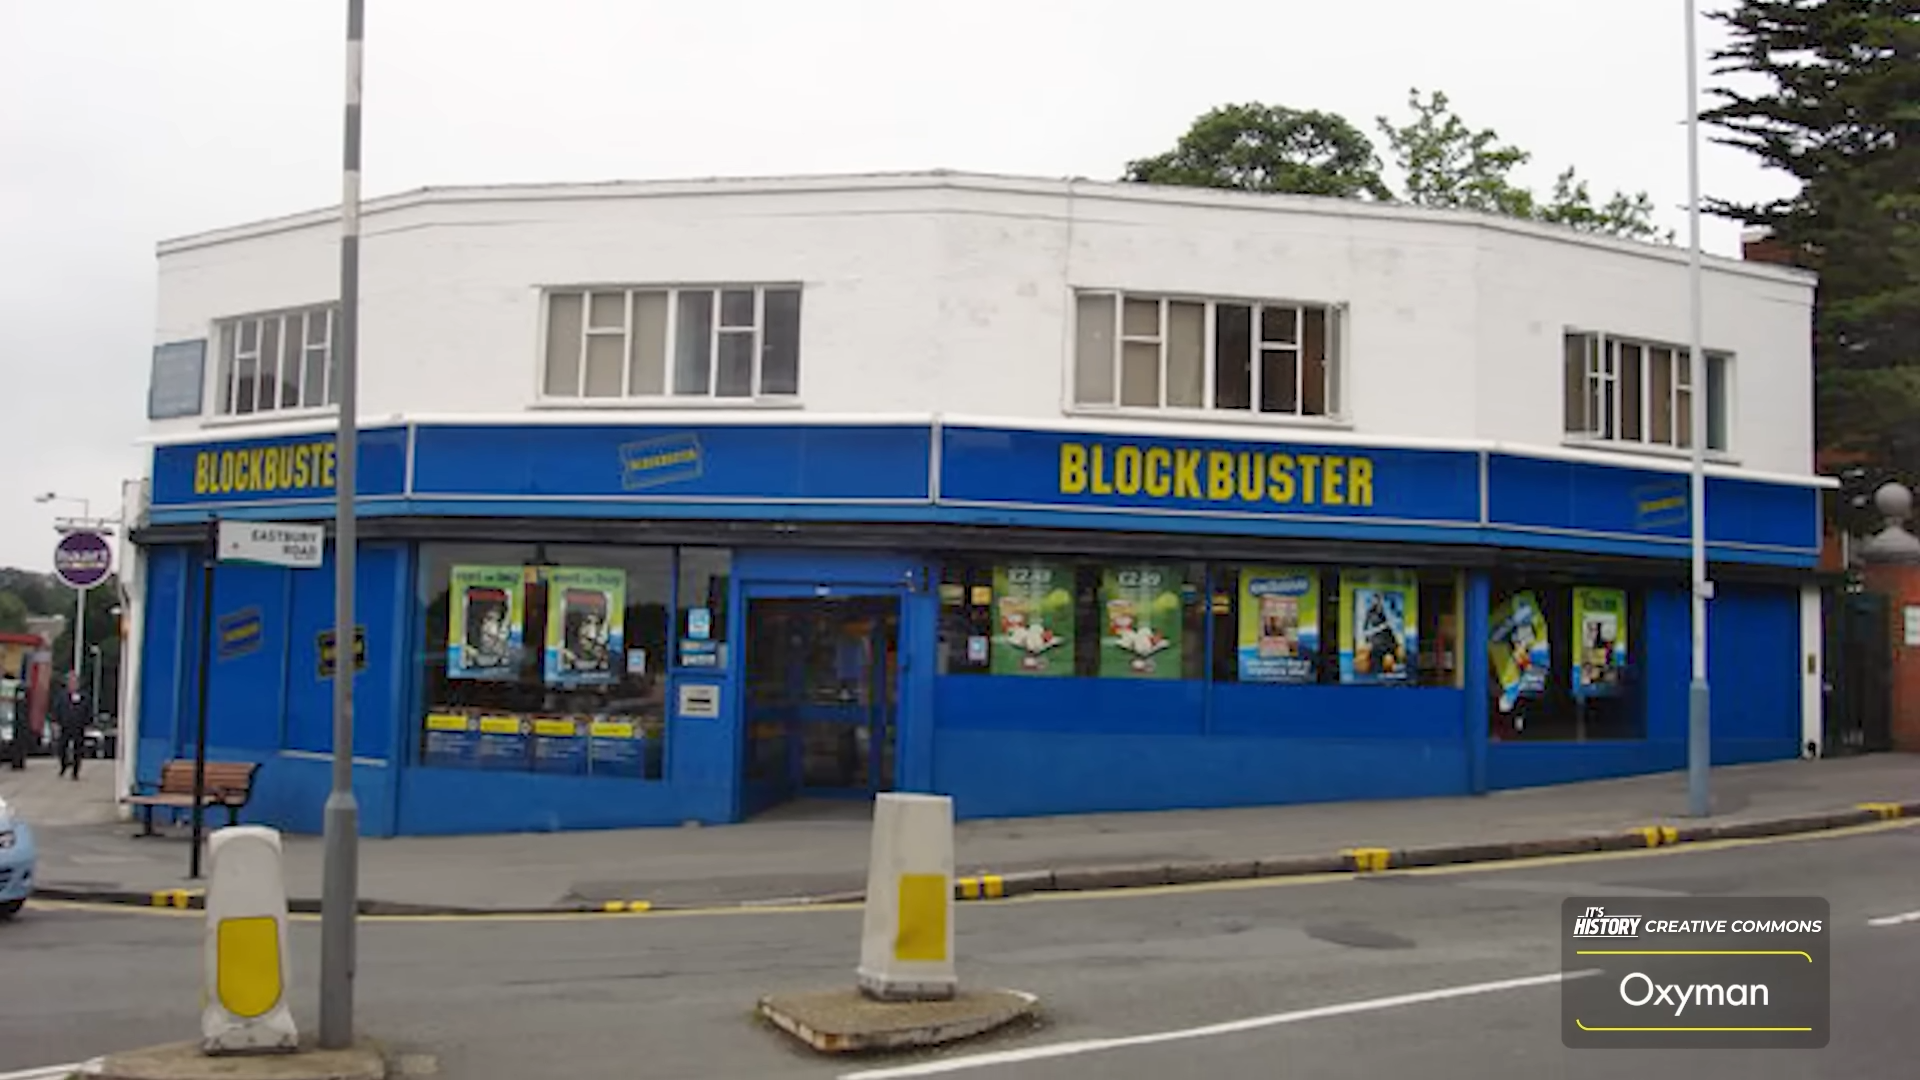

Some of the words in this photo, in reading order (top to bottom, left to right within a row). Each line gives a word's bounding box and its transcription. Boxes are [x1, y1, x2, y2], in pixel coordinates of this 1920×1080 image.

[195, 442, 335, 494] BLOCKBUSTE
[1059, 443, 1374, 506] BLOCKBUSTER
[252, 529, 317, 542] EASTBURY
[283, 545, 317, 556] ROAD
